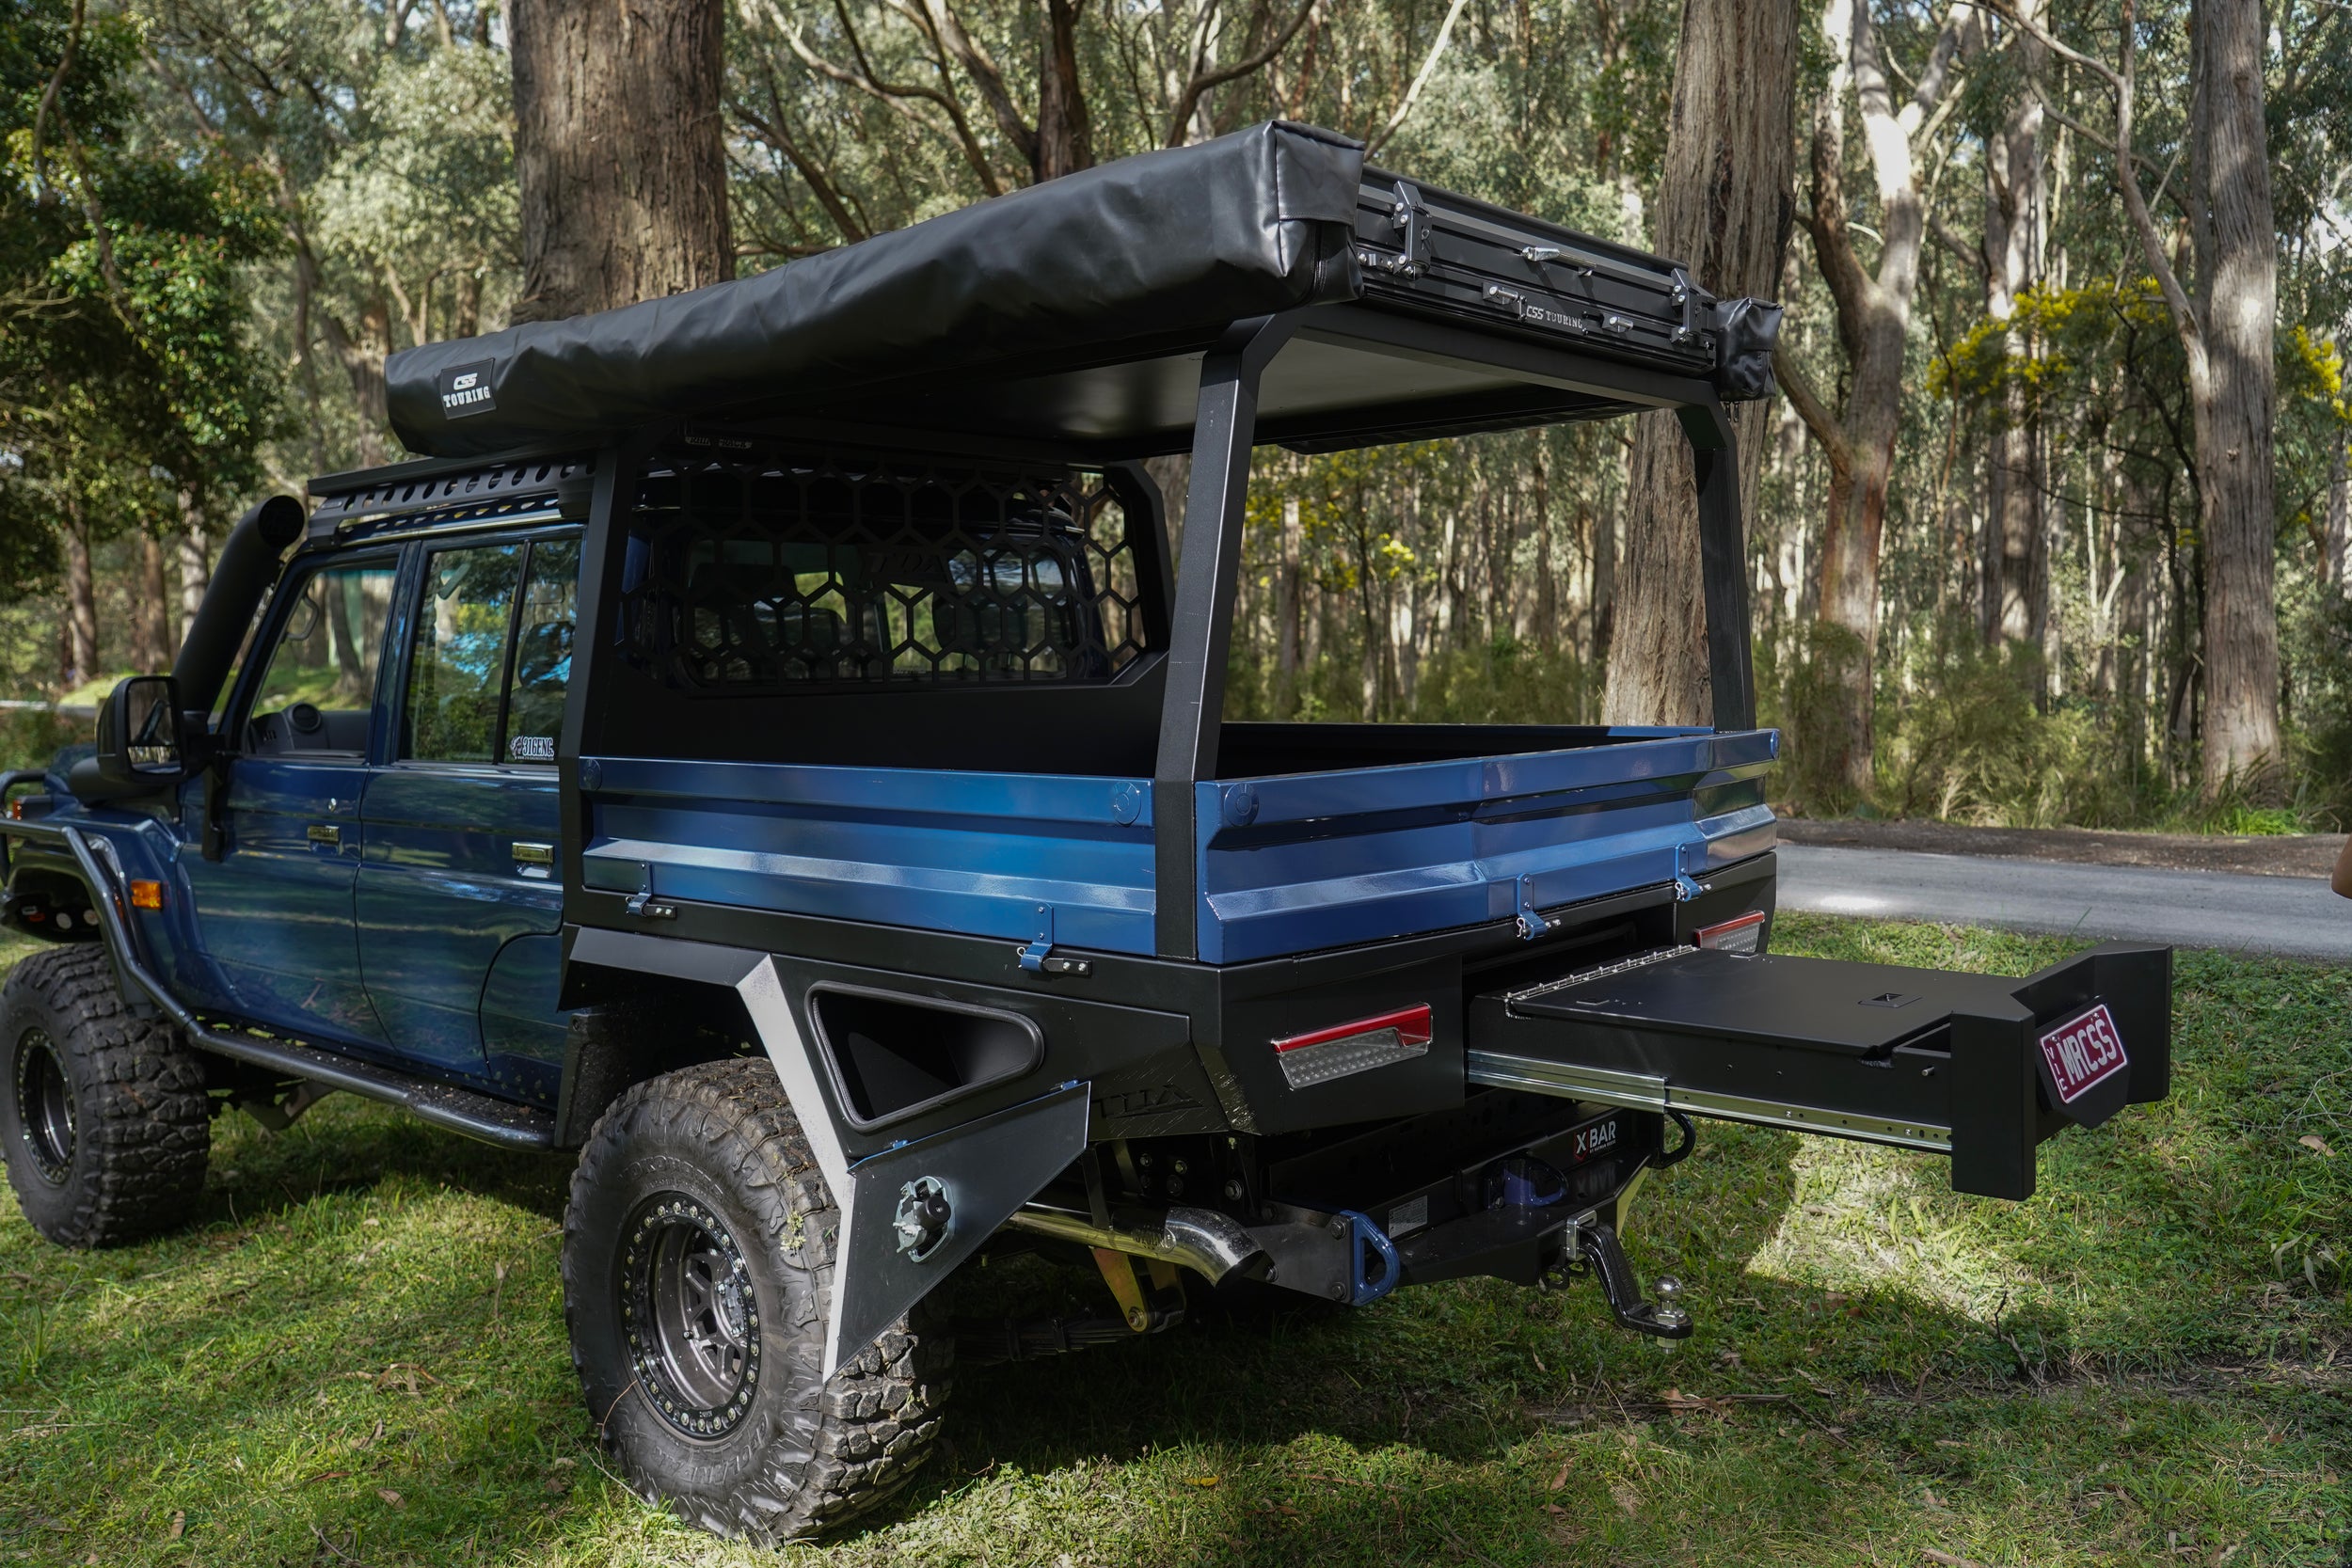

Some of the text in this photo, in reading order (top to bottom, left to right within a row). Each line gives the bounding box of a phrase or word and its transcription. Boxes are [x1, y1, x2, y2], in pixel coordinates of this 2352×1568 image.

[1526, 305, 1583, 328] CSS TOURING
[442, 386, 491, 408] TOURING
[2046, 1046, 2068, 1091] VIC
[2056, 1019, 2117, 1085] MRCSS
